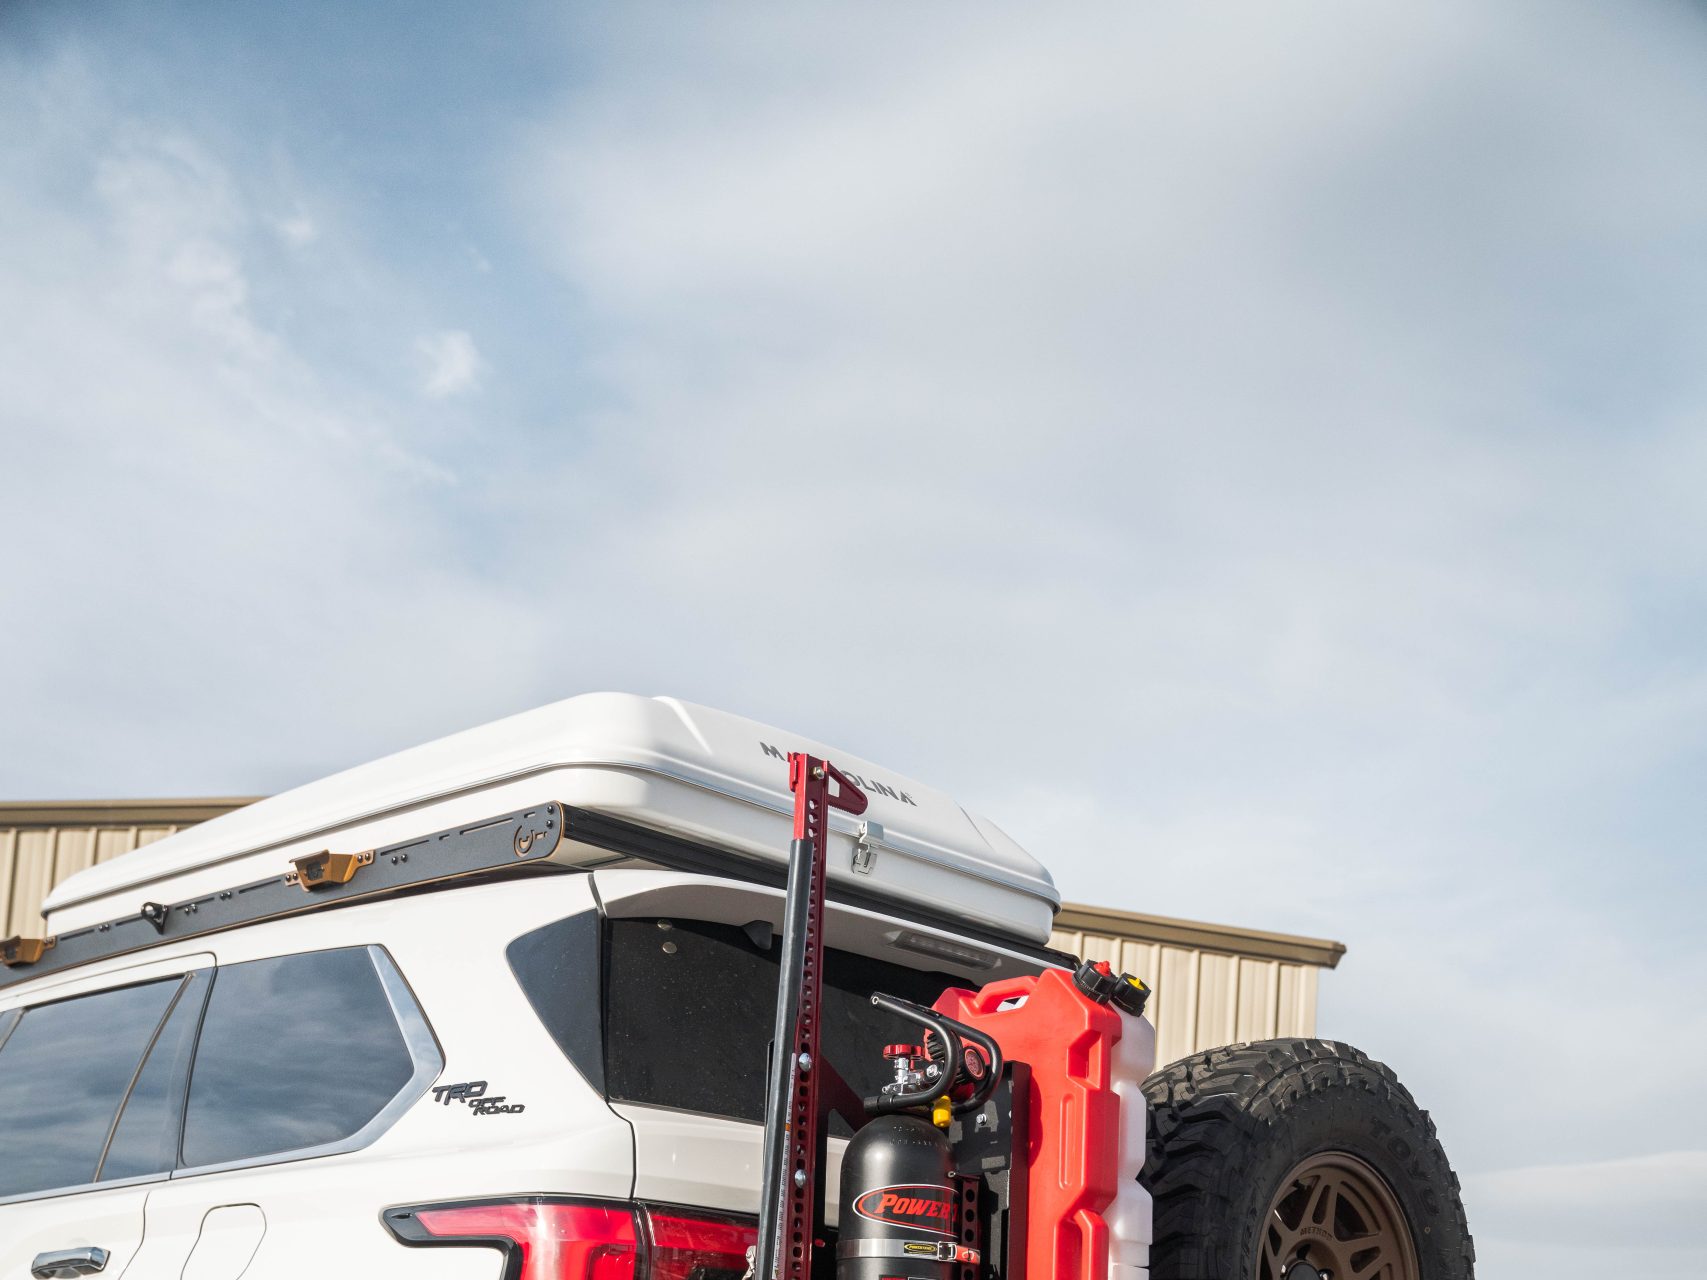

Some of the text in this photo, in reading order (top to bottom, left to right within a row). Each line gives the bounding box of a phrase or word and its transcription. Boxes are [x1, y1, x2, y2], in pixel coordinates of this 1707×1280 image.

[432, 1081, 488, 1106] TRD
[468, 1096, 506, 1108] OFF
[473, 1104, 526, 1116] ROAD
